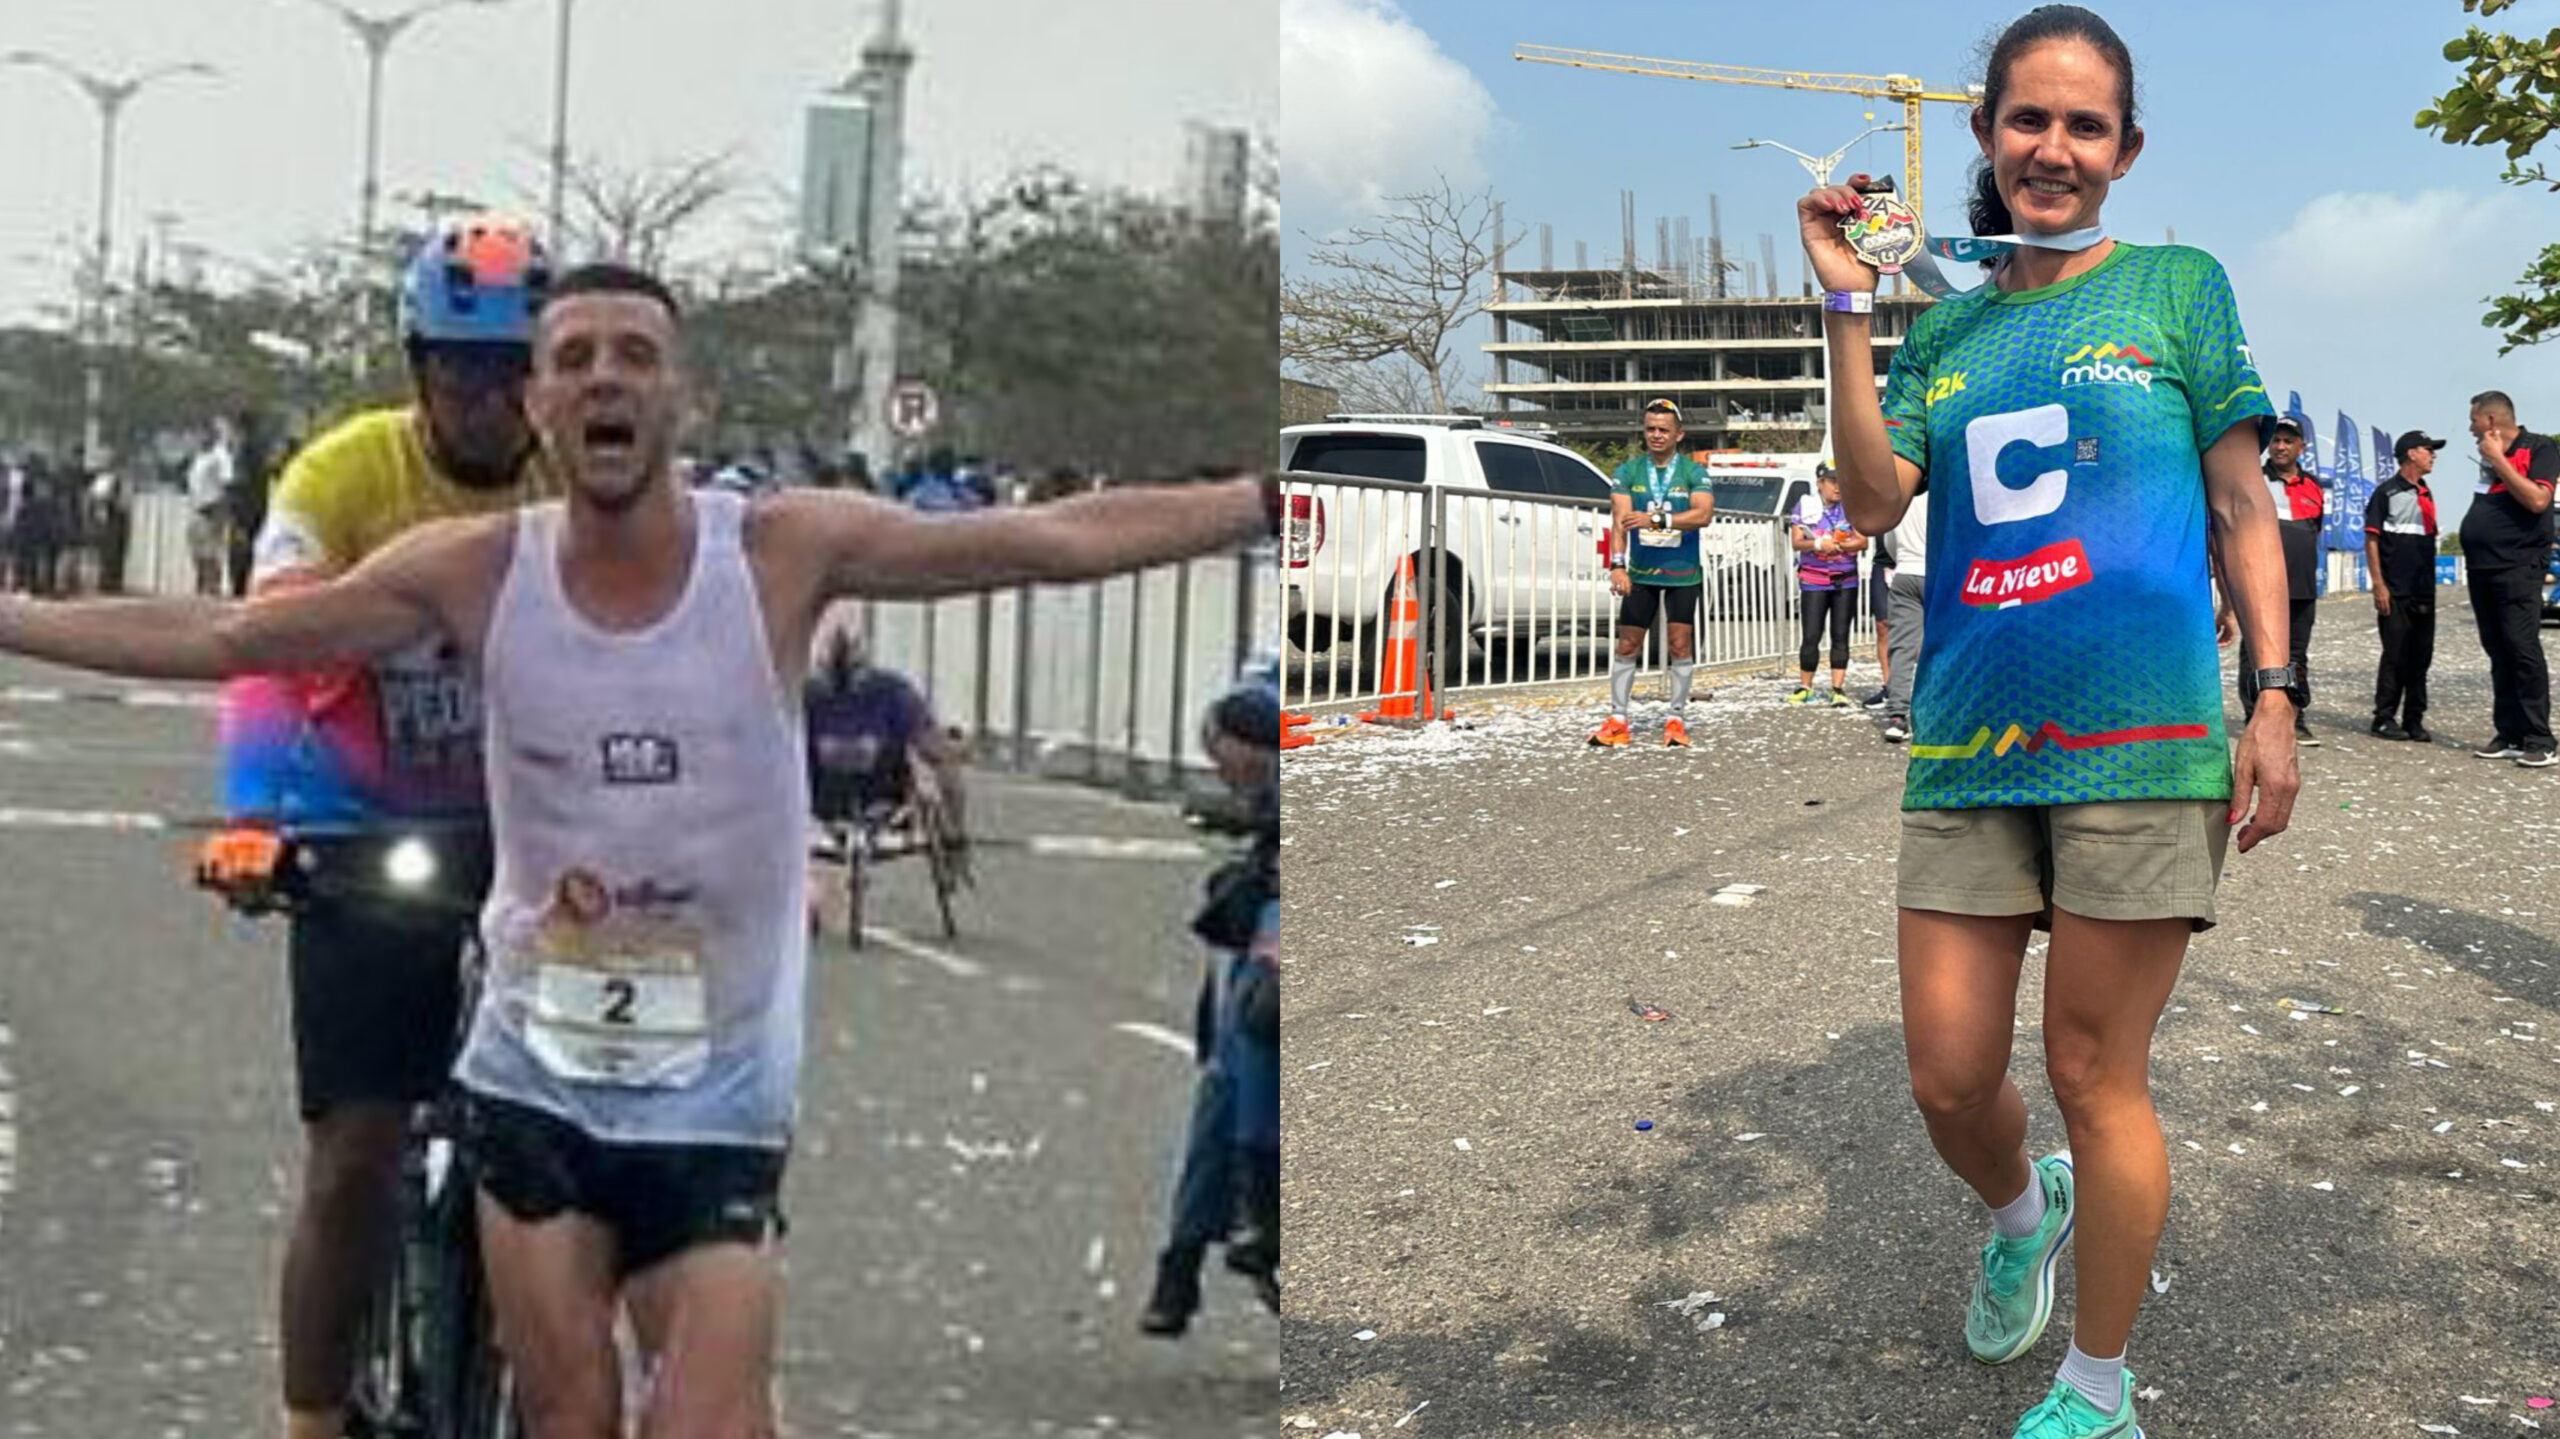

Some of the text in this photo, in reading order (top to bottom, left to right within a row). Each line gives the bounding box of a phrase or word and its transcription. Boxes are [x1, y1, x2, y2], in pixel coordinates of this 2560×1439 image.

[2061, 360, 2153, 392] mbaq
[1965, 403, 2069, 526] C
[1966, 555, 2078, 595] La Nieve
[603, 979, 636, 1024] 2
